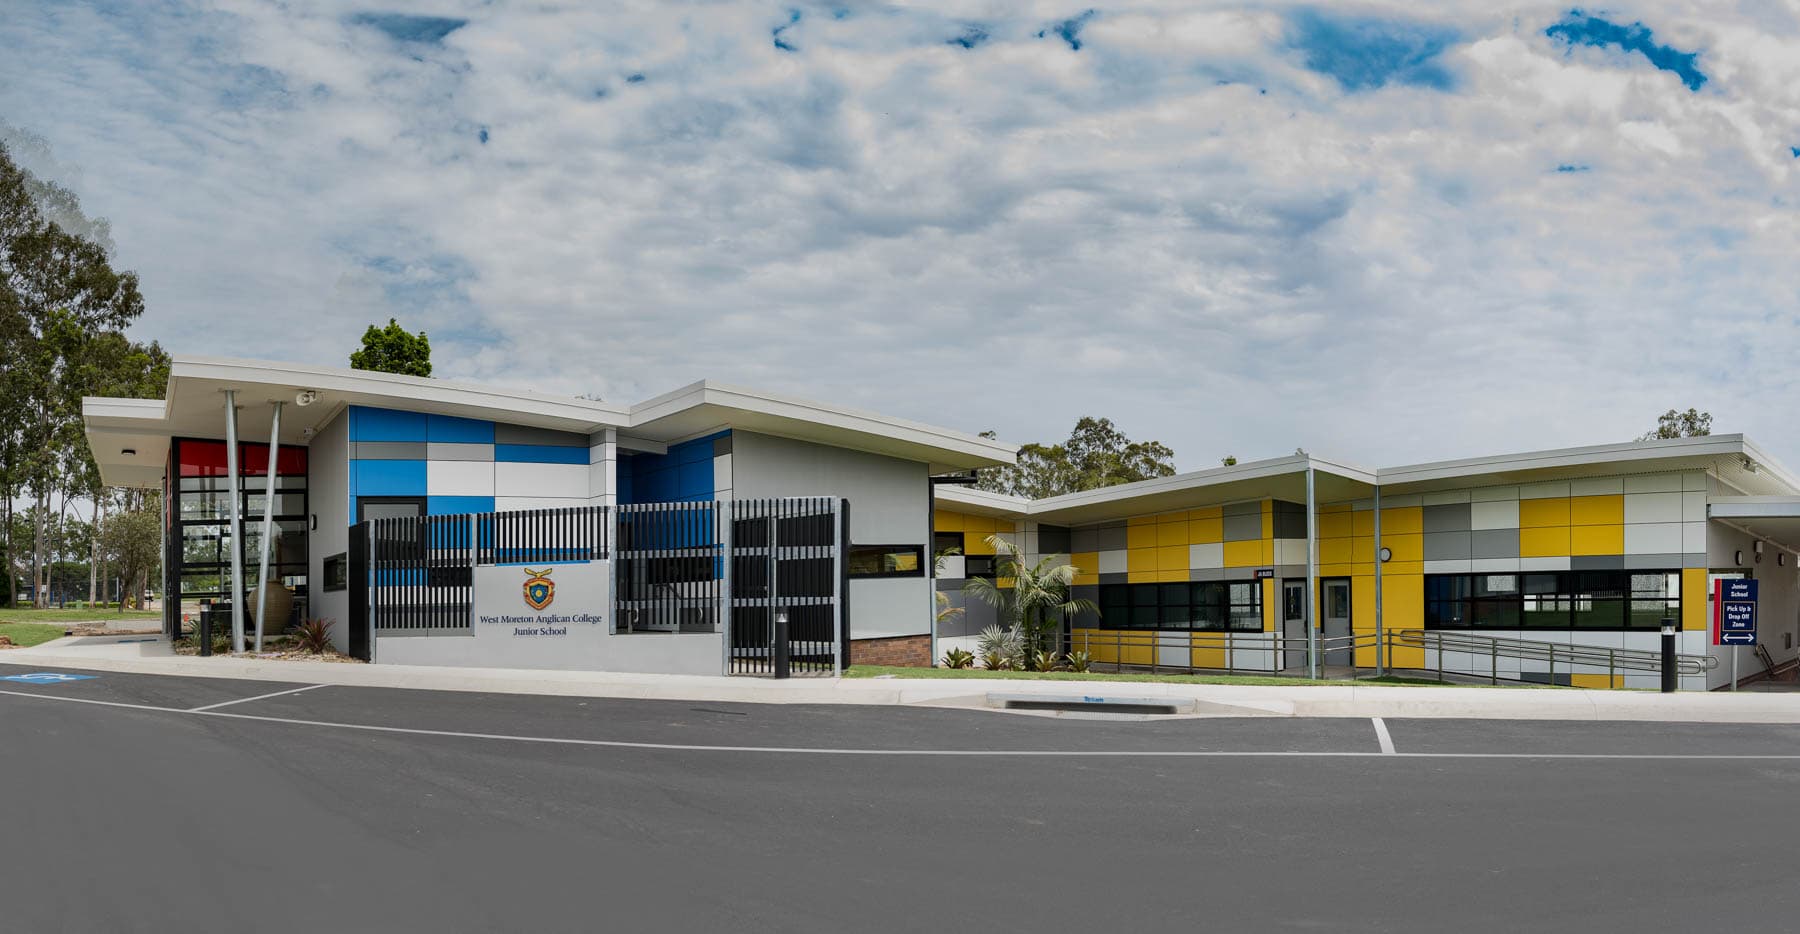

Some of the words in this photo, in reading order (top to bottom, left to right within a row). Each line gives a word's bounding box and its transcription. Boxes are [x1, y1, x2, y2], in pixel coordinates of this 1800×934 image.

[480, 616, 499, 624] West
[536, 615, 570, 624] Anglican
[572, 614, 602, 624] College
[513, 628, 538, 636] Junior
[540, 627, 567, 636] School
